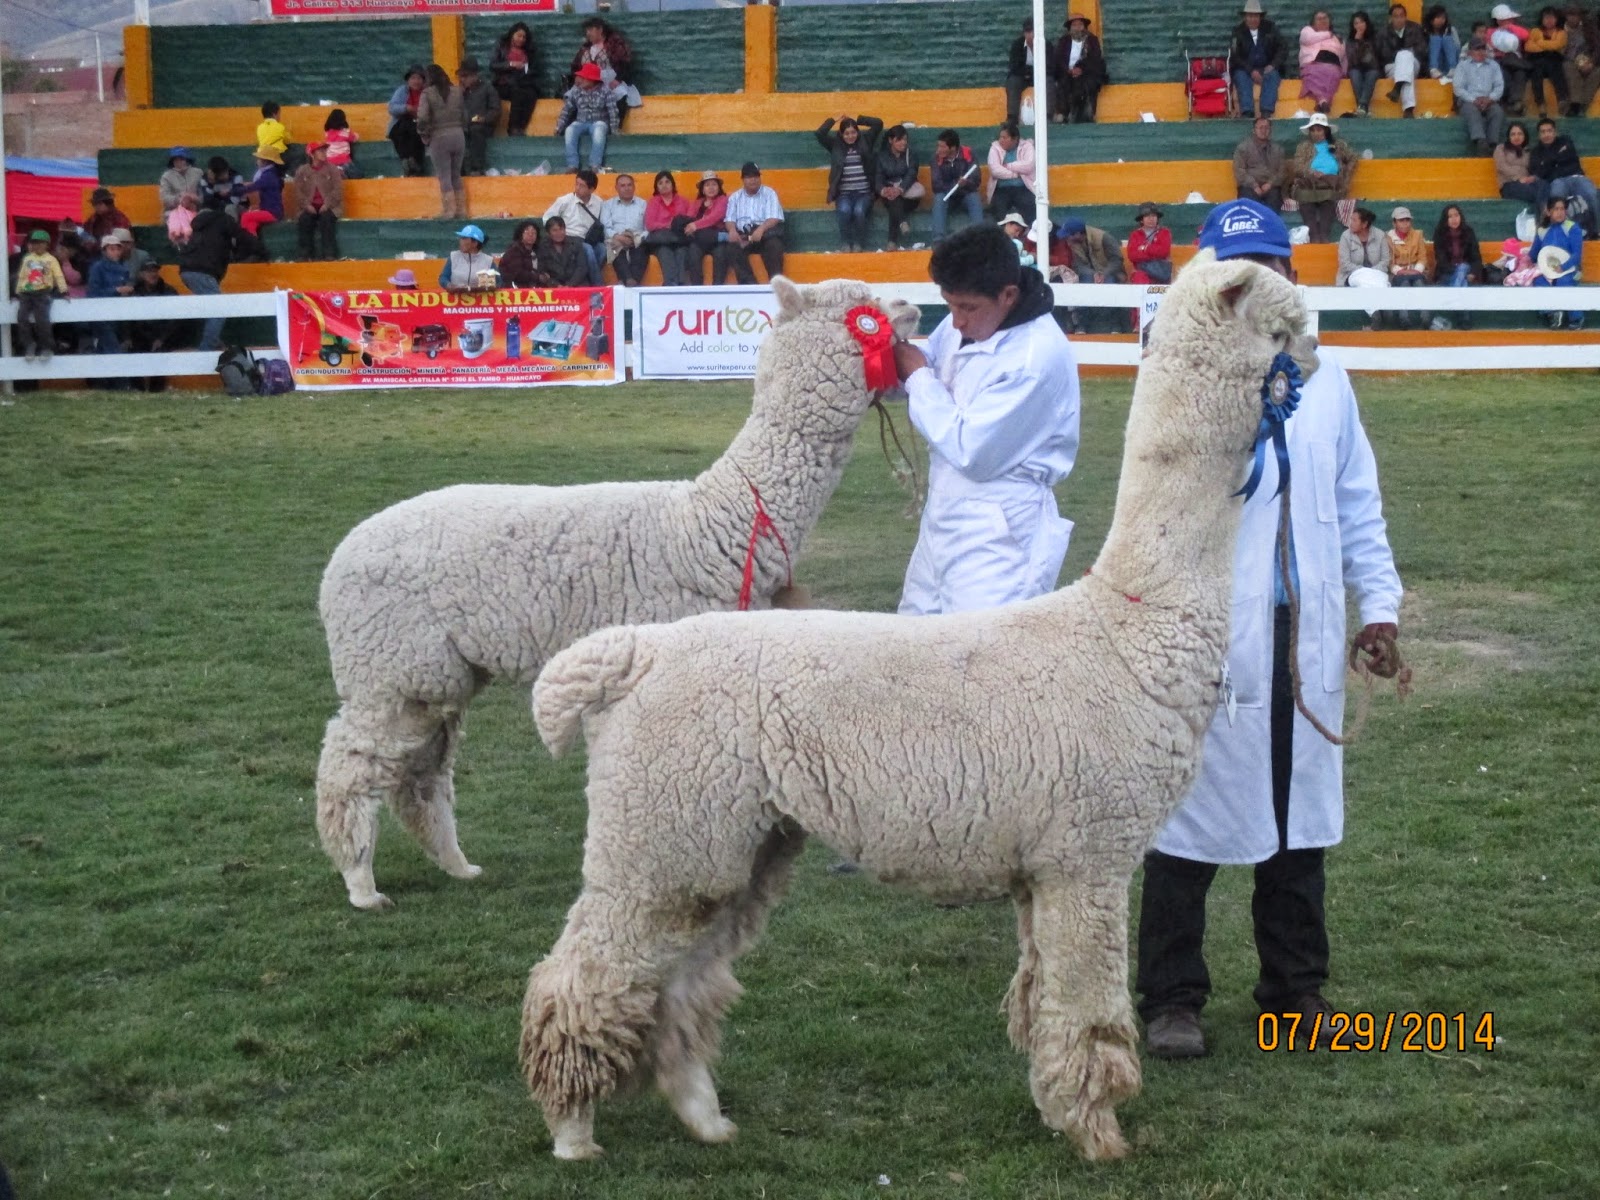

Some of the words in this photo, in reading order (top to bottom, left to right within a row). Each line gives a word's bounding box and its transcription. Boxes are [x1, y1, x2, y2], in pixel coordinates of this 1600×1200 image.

[348, 293, 384, 309] LA
[390, 290, 559, 308] INDUSTRIAL
[443, 306, 494, 314] MAQUINAS
[505, 305, 581, 313] HERRAMIENTAS
[680, 341, 704, 353] Add
[707, 340, 735, 353] color
[738, 342, 749, 352] to
[417, 365, 446, 374] MINERÍA
[452, 365, 492, 374] PANADERÍA
[561, 363, 609, 371] CARPINTERÍA
[687, 364, 757, 372] www.suritexperu.co
